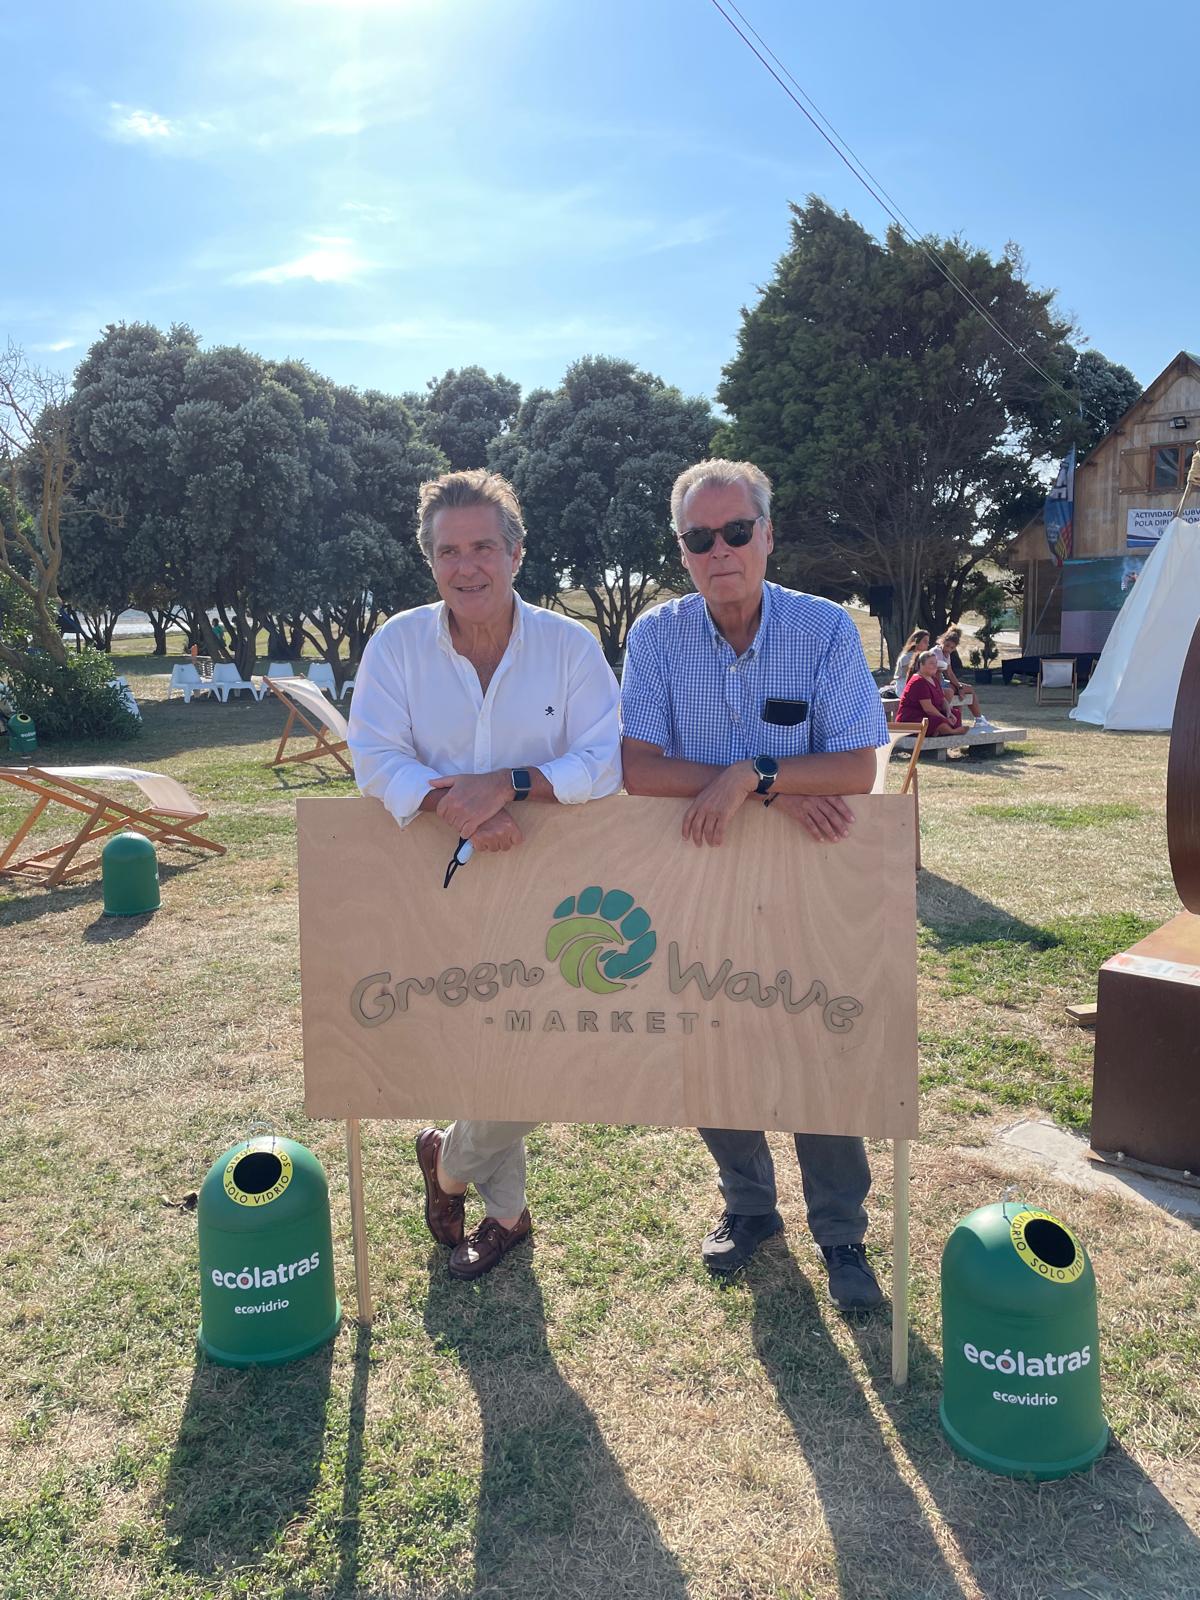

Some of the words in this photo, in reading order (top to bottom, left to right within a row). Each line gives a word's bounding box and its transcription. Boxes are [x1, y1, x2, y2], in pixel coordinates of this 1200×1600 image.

[1134, 519, 1153, 527] POLA
[1135, 511, 1176, 519] ACTIVIDAD
[350, 959, 545, 1029] Green
[668, 941, 864, 1034] Wave
[225, 1180, 248, 1204] SOLO
[253, 1175, 289, 1204] VIDRIO
[1012, 1215, 1029, 1251] VIDRIO
[211, 1251, 320, 1290] ecólatras
[1030, 1257, 1066, 1280] SOLO
[234, 1298, 290, 1314] ecovidrio
[963, 1342, 1091, 1377] ecólatras
[992, 1390, 1058, 1406] ecovidrio
